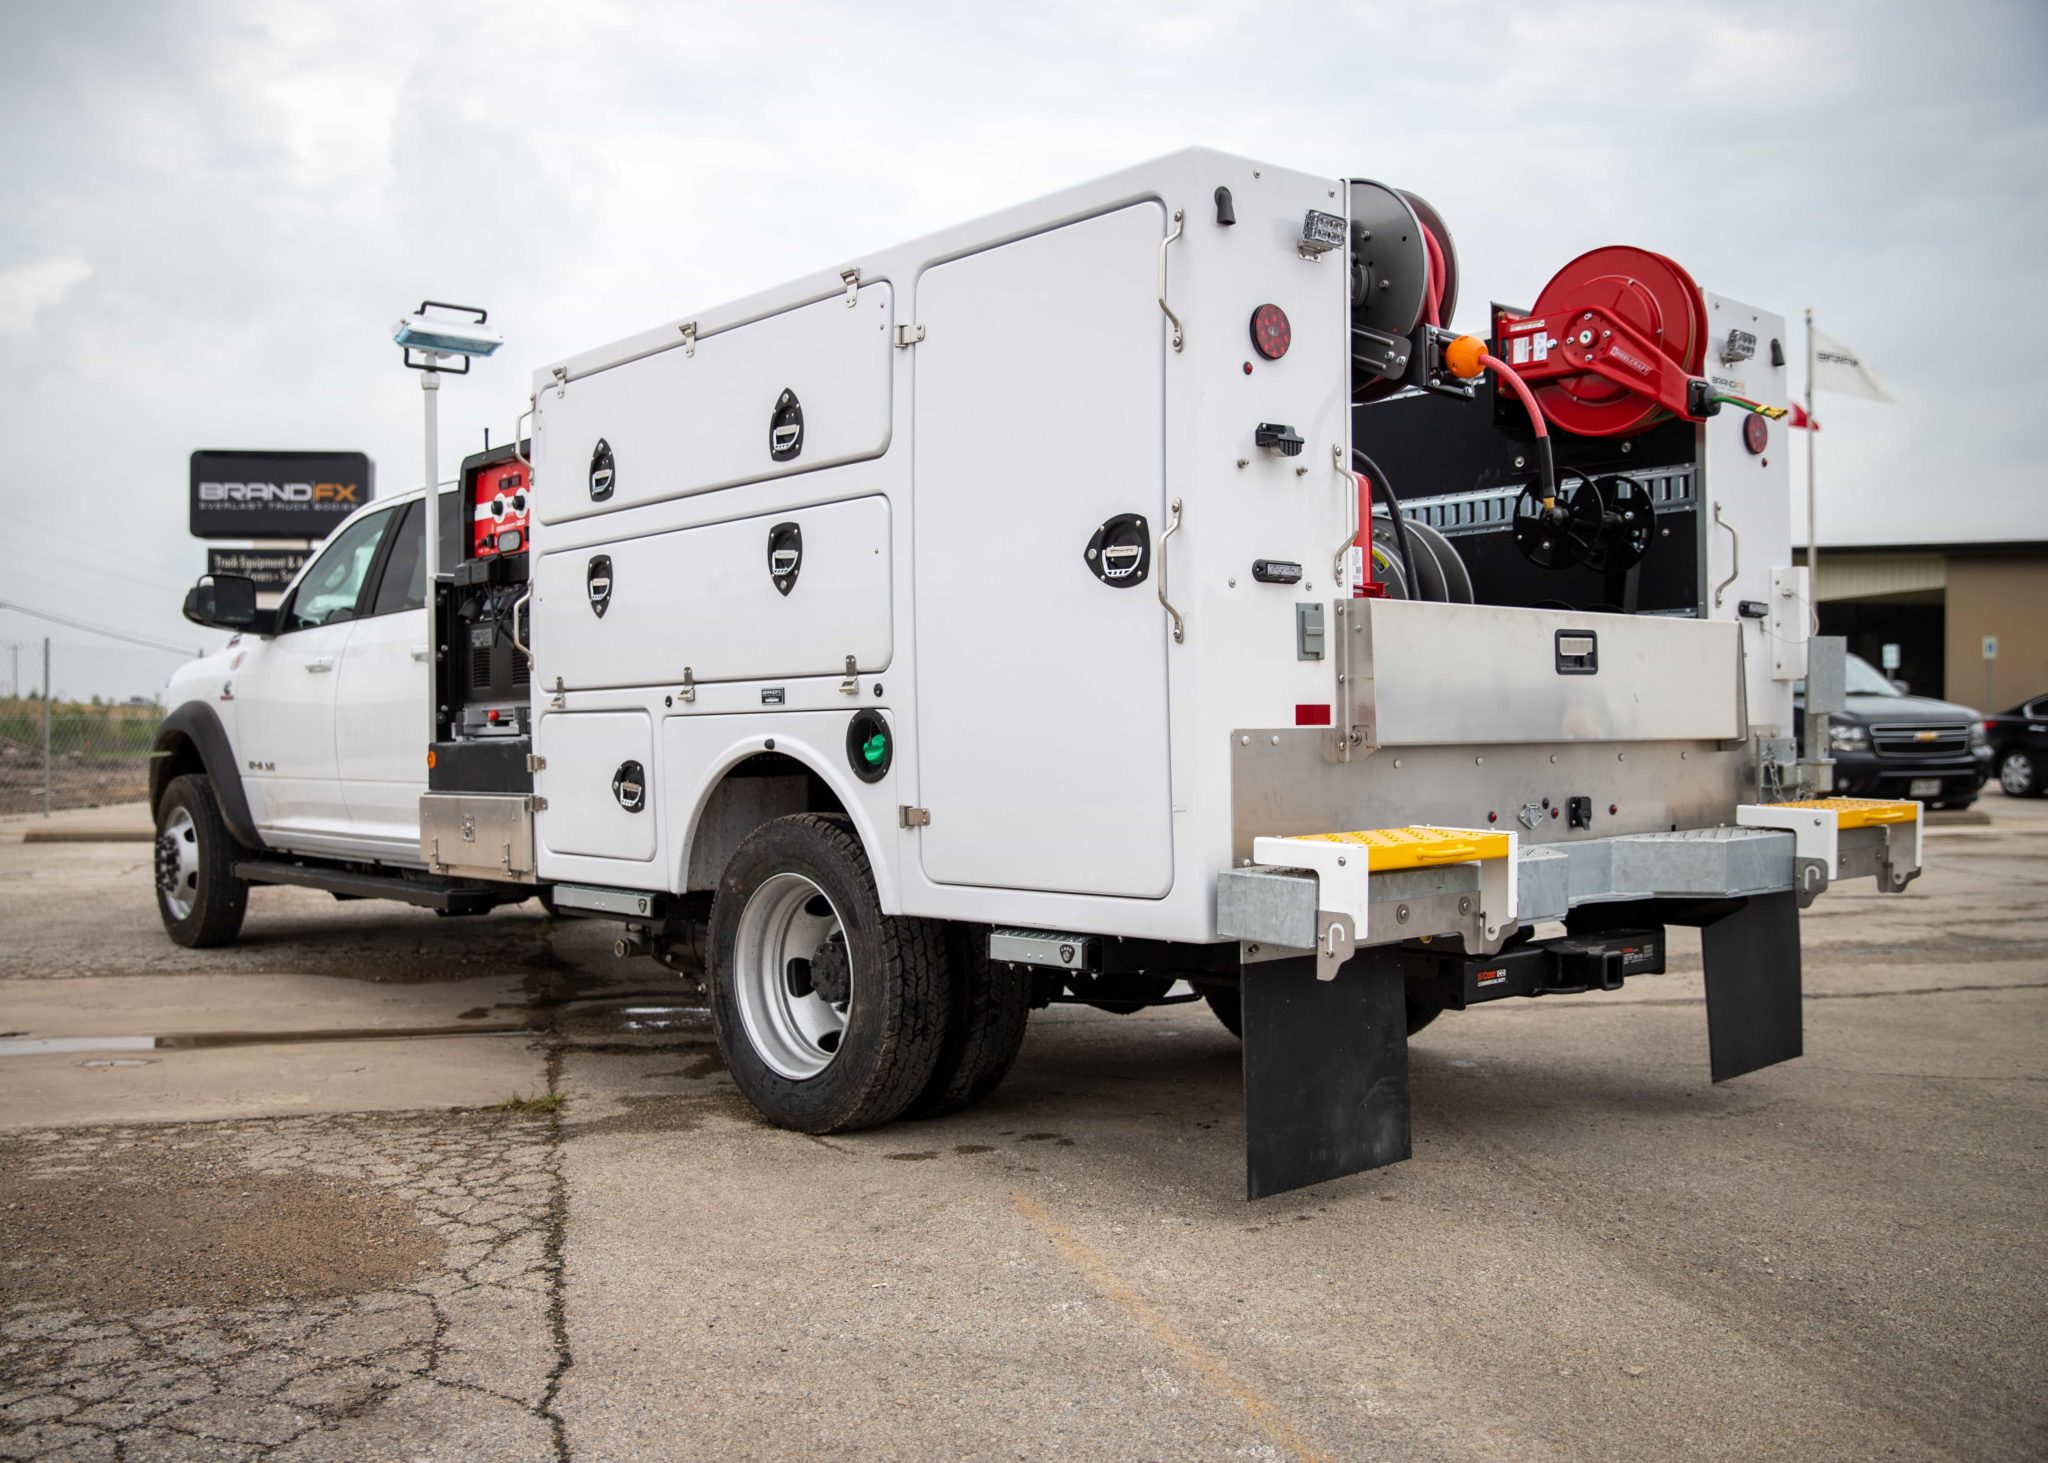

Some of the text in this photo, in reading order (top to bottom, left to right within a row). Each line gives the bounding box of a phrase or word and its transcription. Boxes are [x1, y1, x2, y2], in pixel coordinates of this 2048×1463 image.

[1616, 350, 1650, 375] REELCRAFT
[199, 482, 357, 502] BRANDFX
[269, 502, 309, 511] TRUCK
[214, 554, 238, 569] Truck
[239, 554, 286, 571] Equipment
[287, 555, 295, 570] &
